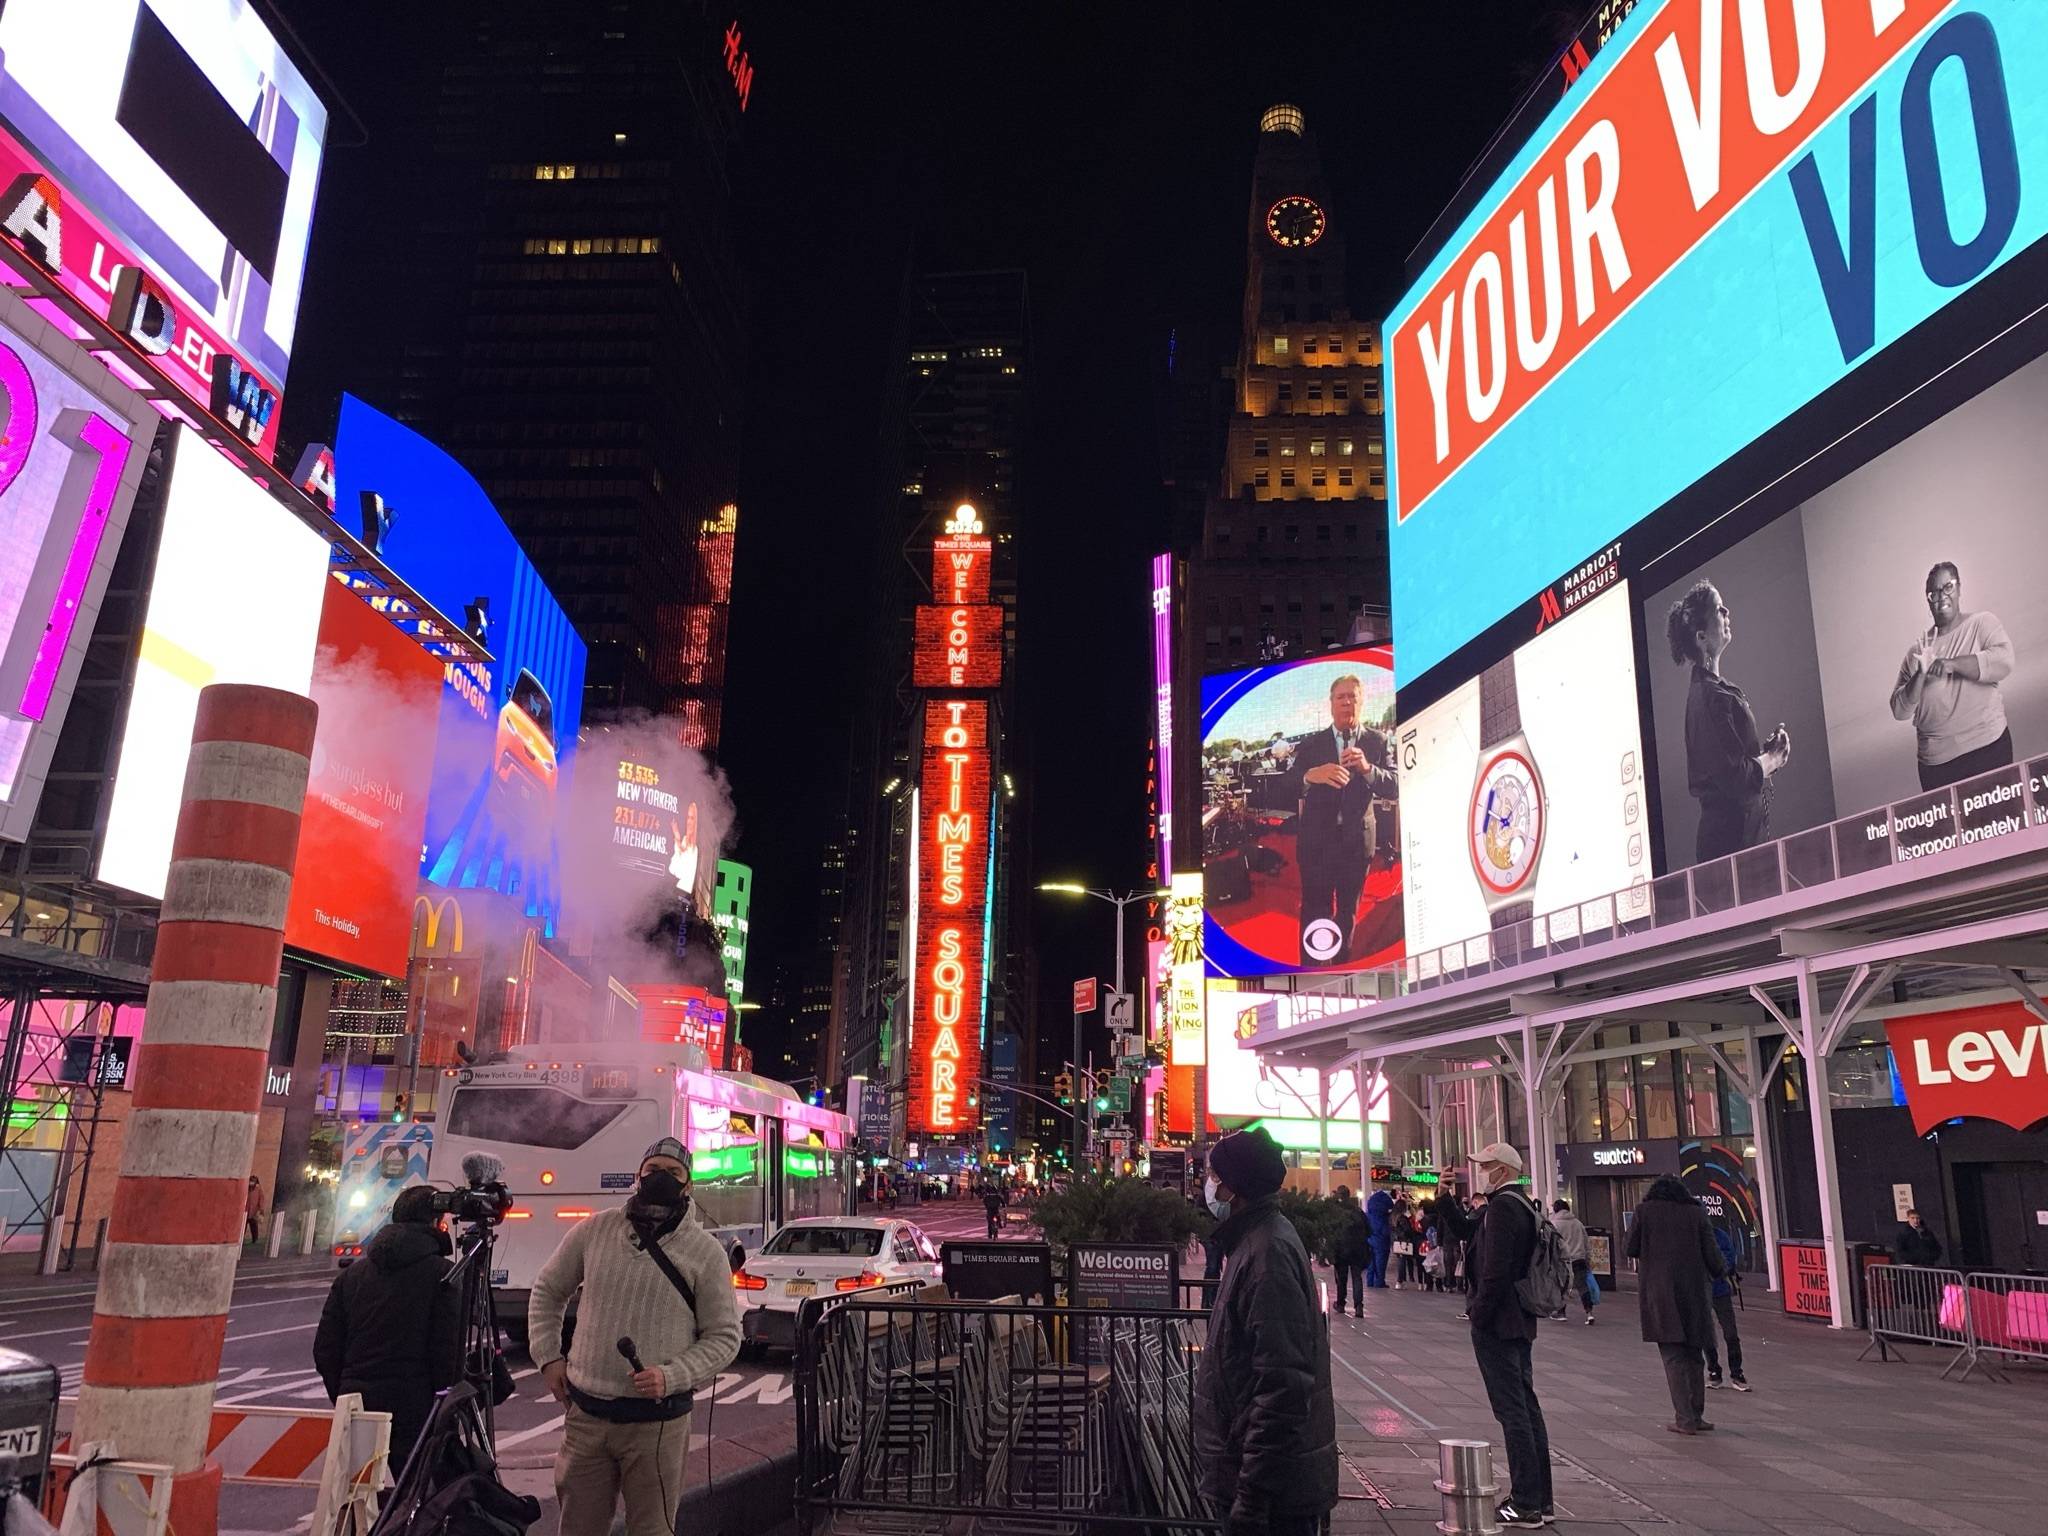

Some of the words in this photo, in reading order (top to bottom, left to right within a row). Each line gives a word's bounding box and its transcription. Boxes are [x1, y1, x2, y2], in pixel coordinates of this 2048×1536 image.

[723, 20, 753, 112] H&M
[1787, 11, 2021, 365] VO
[1416, 119, 1632, 464] YOUR
[1654, 0, 1905, 212] VO
[945, 520, 983, 534] 2020
[935, 541, 959, 549] TIMES
[960, 541, 992, 549] SQUARE
[1564, 543, 1622, 593] MARRIOTT
[1565, 565, 1616, 609] MARQUIS
[947, 553, 973, 685] WELCOME
[443, 662, 488, 720] NOUGH.
[944, 702, 967, 748] TO
[1404, 743, 1417, 771] Q
[384, 780, 404, 814] hut
[617, 781, 641, 801] NEW
[642, 786, 679, 814] YORKERS.
[1866, 822, 1889, 841] that
[1894, 803, 1948, 833] brought
[1963, 777, 2039, 817] pandemc
[612, 826, 668, 855] AMERICANS.
[938, 754, 971, 905] TIMES
[1898, 815, 2020, 862] isproporionately
[314, 908, 330, 927] This
[332, 914, 360, 938] Holiday,
[1176, 1000, 1199, 1013] LION
[1179, 989, 1195, 997] THE
[931, 929, 964, 1126] SQUARE
[1174, 1015, 1202, 1031] KING
[24, 1032, 67, 1061] SSN.
[266, 1068, 291, 1097] hut
[507, 1071, 522, 1080] City
[540, 1070, 579, 1085] 4398
[1404, 1149, 1431, 1167] 1515
[1593, 1147, 1636, 1165] swatch
[1703, 1195, 1722, 1205] BOLD
[1707, 1206, 1723, 1216] ONO
[964, 1254, 987, 1263] TIMES
[988, 1254, 1018, 1263] SQUARE
[1019, 1255, 1040, 1263] ARTS
[1078, 1251, 1169, 1270] Welcome!
[1798, 1249, 1817, 1266] ALL
[1796, 1292, 1832, 1312] SQUAR
